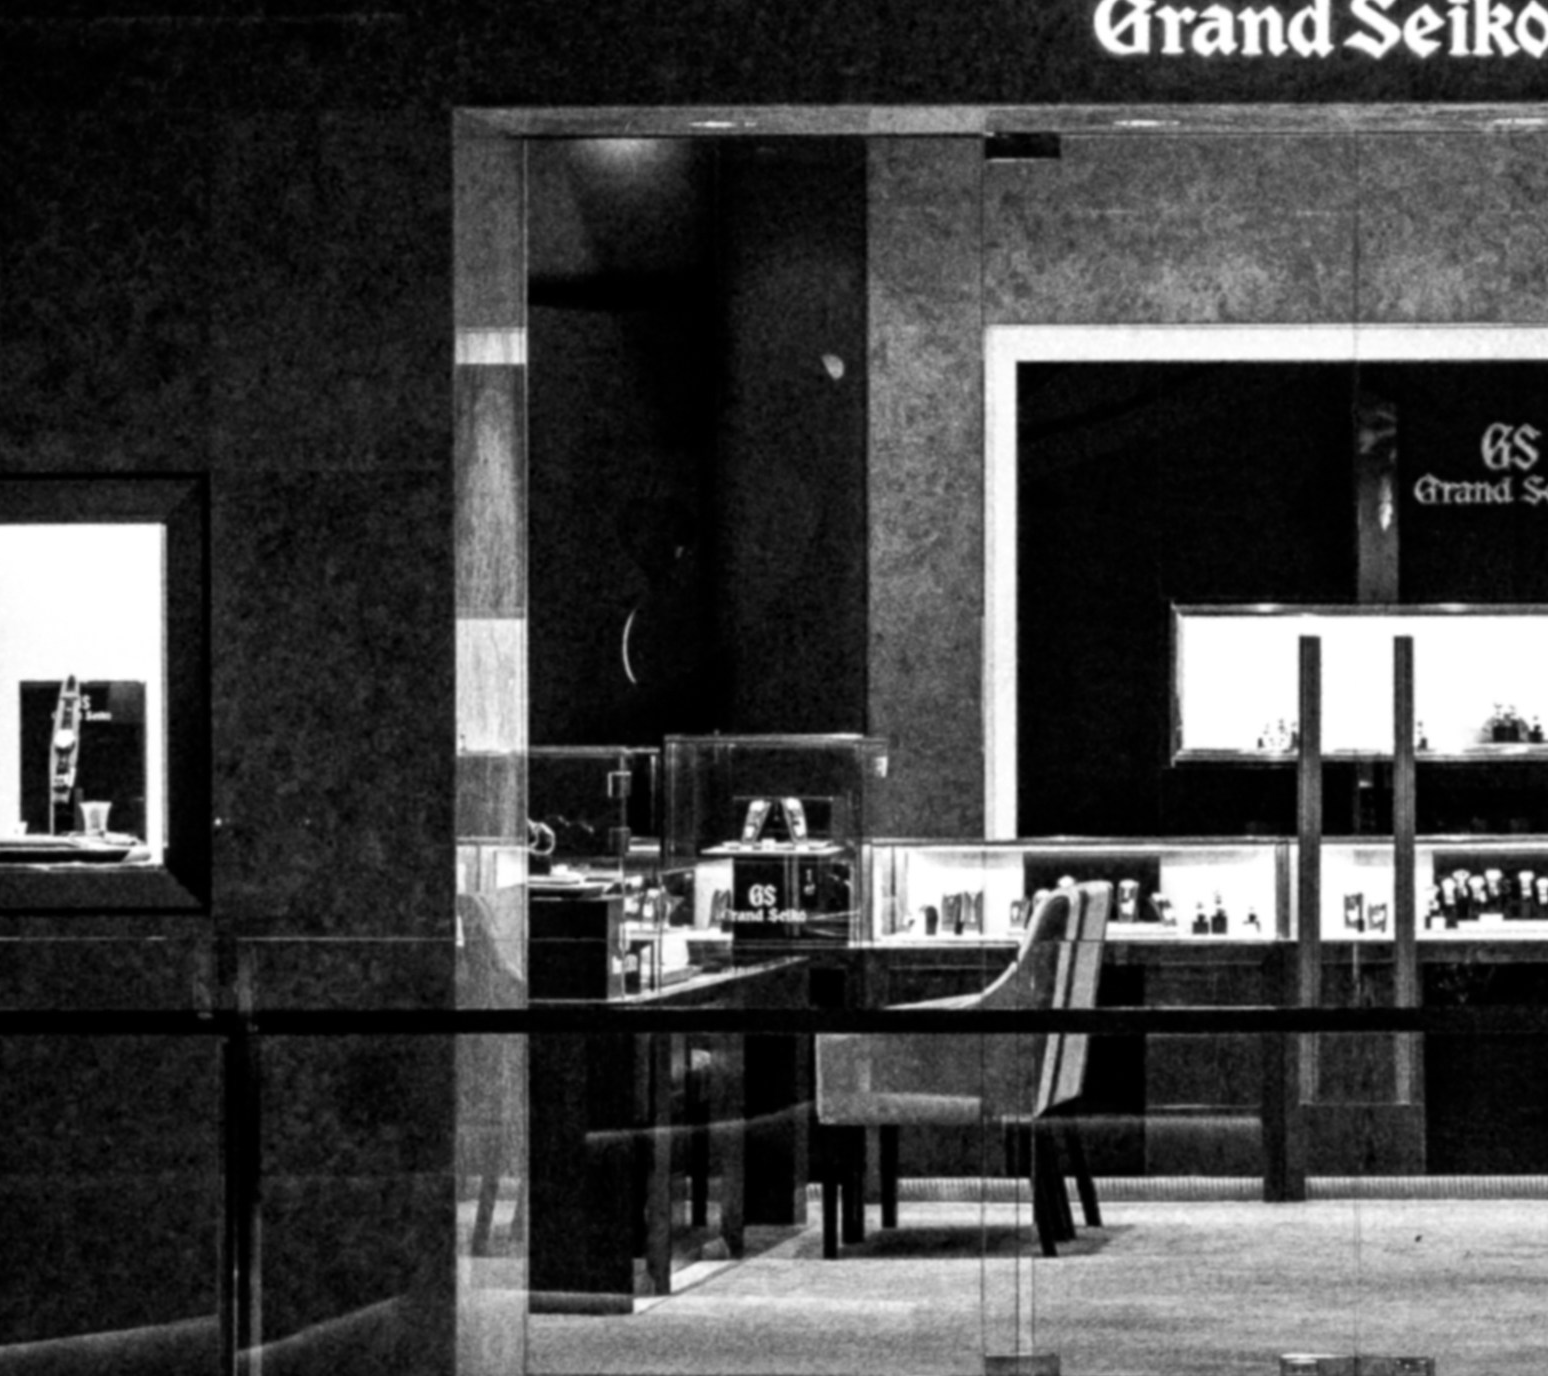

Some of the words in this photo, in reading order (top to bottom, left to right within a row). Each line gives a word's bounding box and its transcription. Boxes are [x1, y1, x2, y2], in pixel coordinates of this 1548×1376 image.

[1480, 422, 1543, 471] GS
[1413, 472, 1513, 505] Grand
[748, 883, 777, 907] GS
